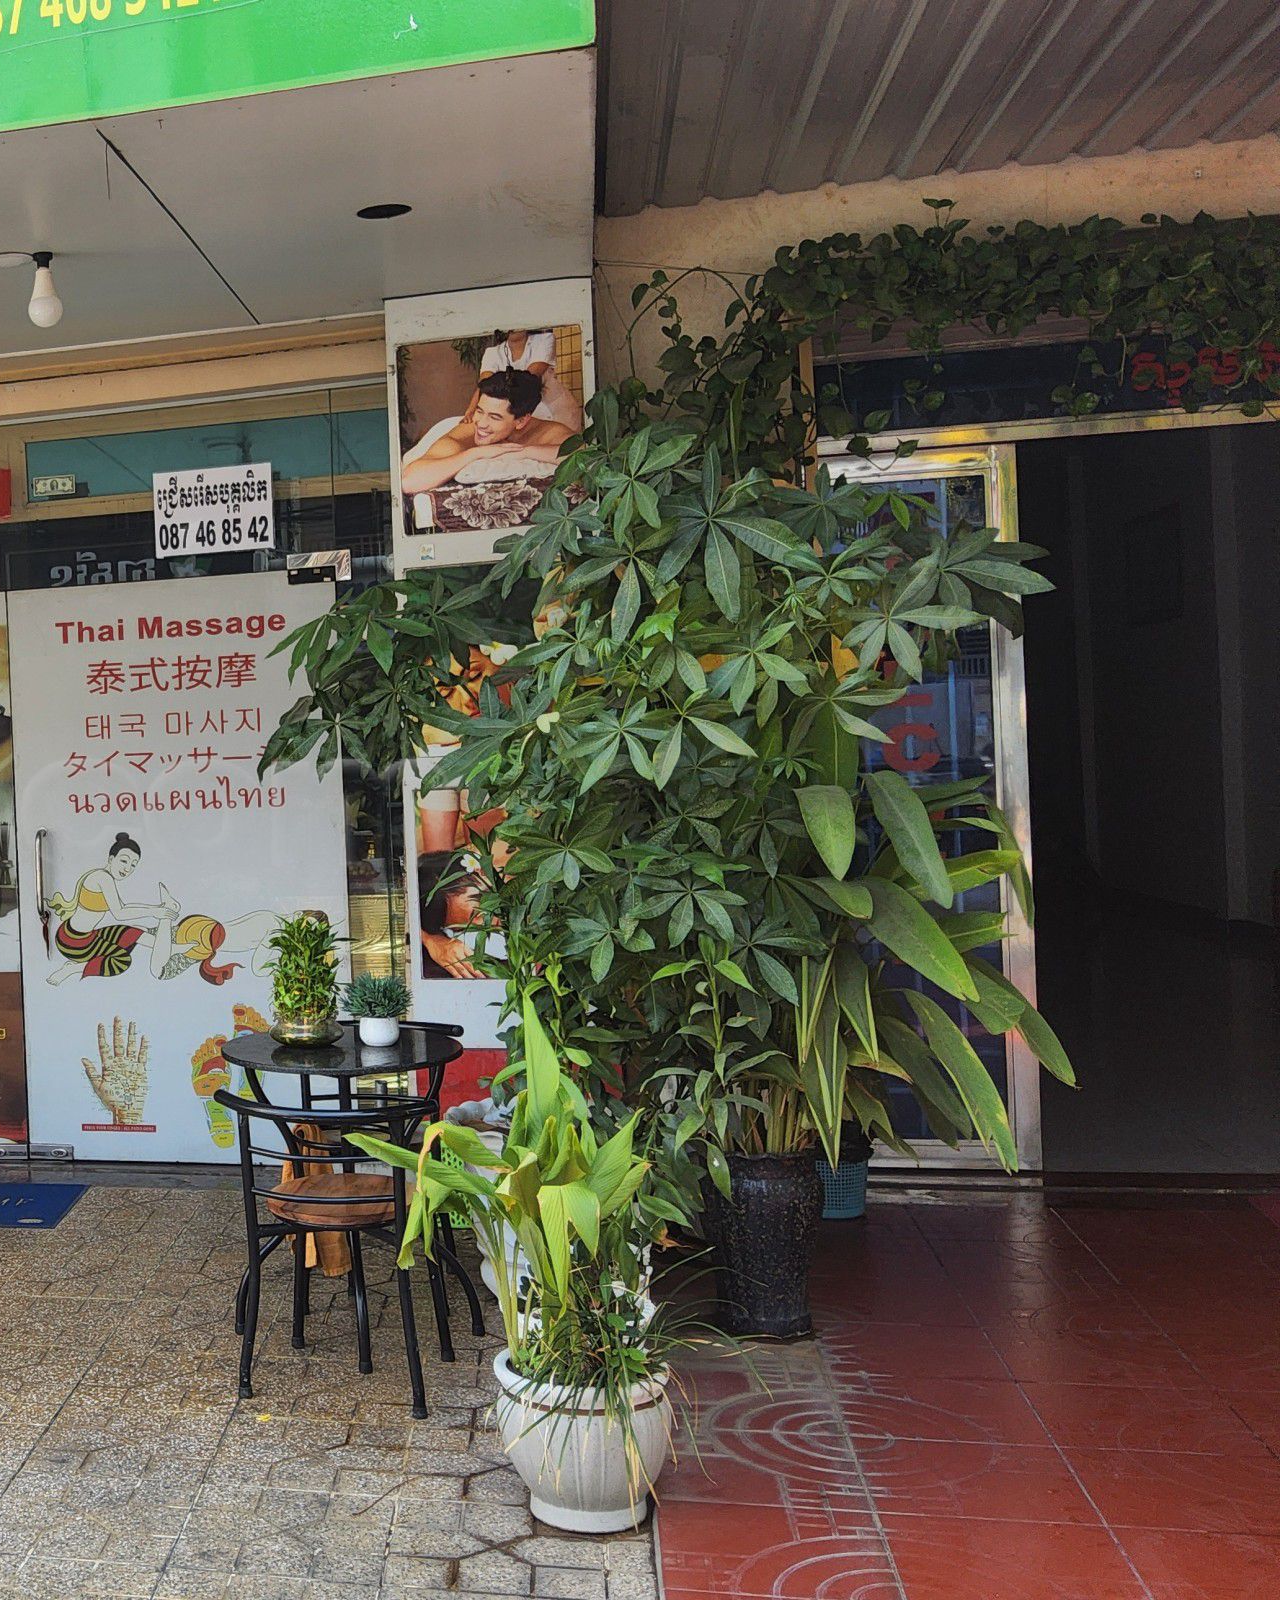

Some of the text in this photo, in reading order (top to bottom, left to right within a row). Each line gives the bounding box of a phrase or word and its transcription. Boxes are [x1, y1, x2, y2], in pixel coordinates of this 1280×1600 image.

[159, 515, 269, 550] 087 46 85 42
[55, 613, 287, 645] Thai Massage
[86, 652, 257, 695] 泰式按摩
[85, 707, 261, 740] 태국 마사지
[68, 776, 286, 814] นวดแผนไทย
